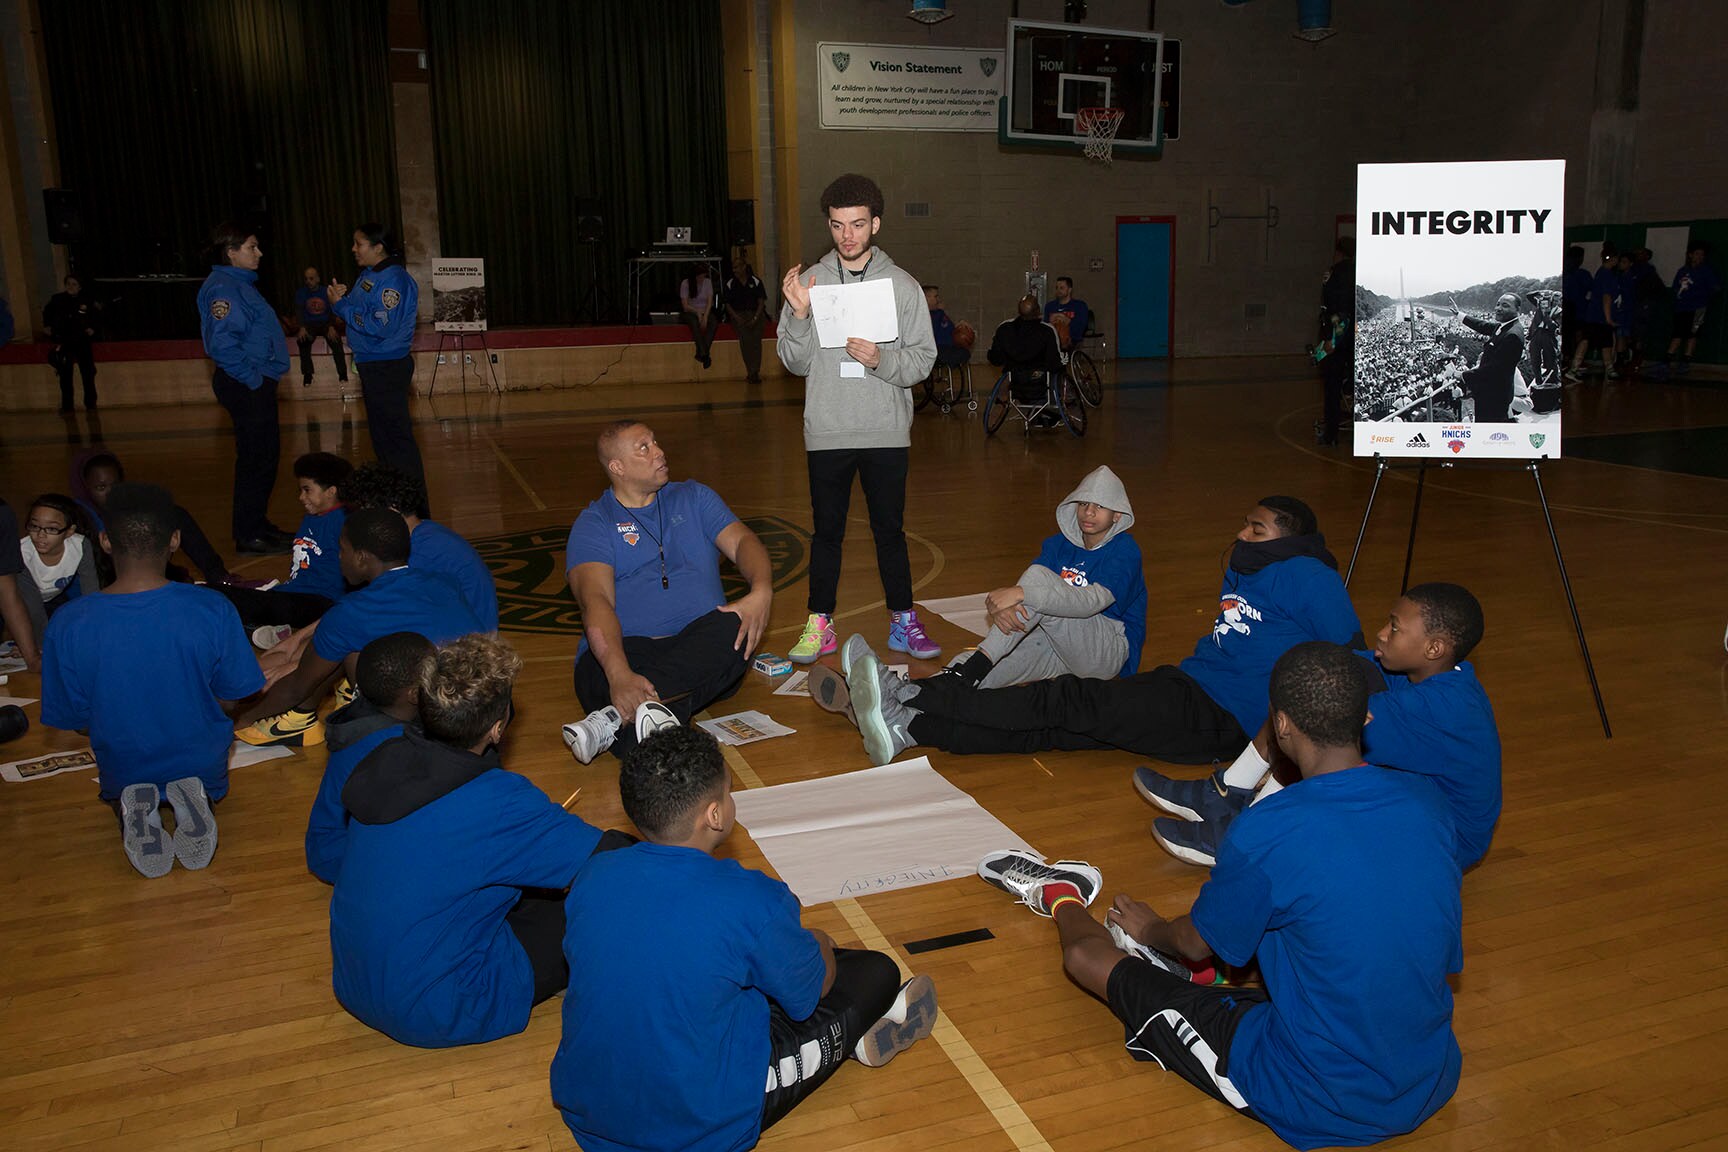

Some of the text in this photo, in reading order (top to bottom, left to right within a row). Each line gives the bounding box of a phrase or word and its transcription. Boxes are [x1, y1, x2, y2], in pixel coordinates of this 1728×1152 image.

[869, 61, 963, 74] Vision Statement
[1040, 60, 1065, 72] HOM
[831, 84, 841, 92] All
[904, 86, 917, 95] City
[949, 87, 960, 95] fun
[960, 88, 977, 96] place
[835, 95, 851, 103] learn
[911, 98, 920, 106] by
[925, 98, 947, 106] special
[947, 99, 982, 107] relationship
[839, 107, 858, 115] youth
[858, 107, 898, 116] development
[898, 108, 938, 116] professionals
[951, 109, 969, 117] police
[1371, 209, 1552, 235] INTEGRITY
[1442, 430, 1471, 438] KNICKS
[840, 864, 955, 895] INTEGRITY
[829, 1021, 843, 1063] ELITE
